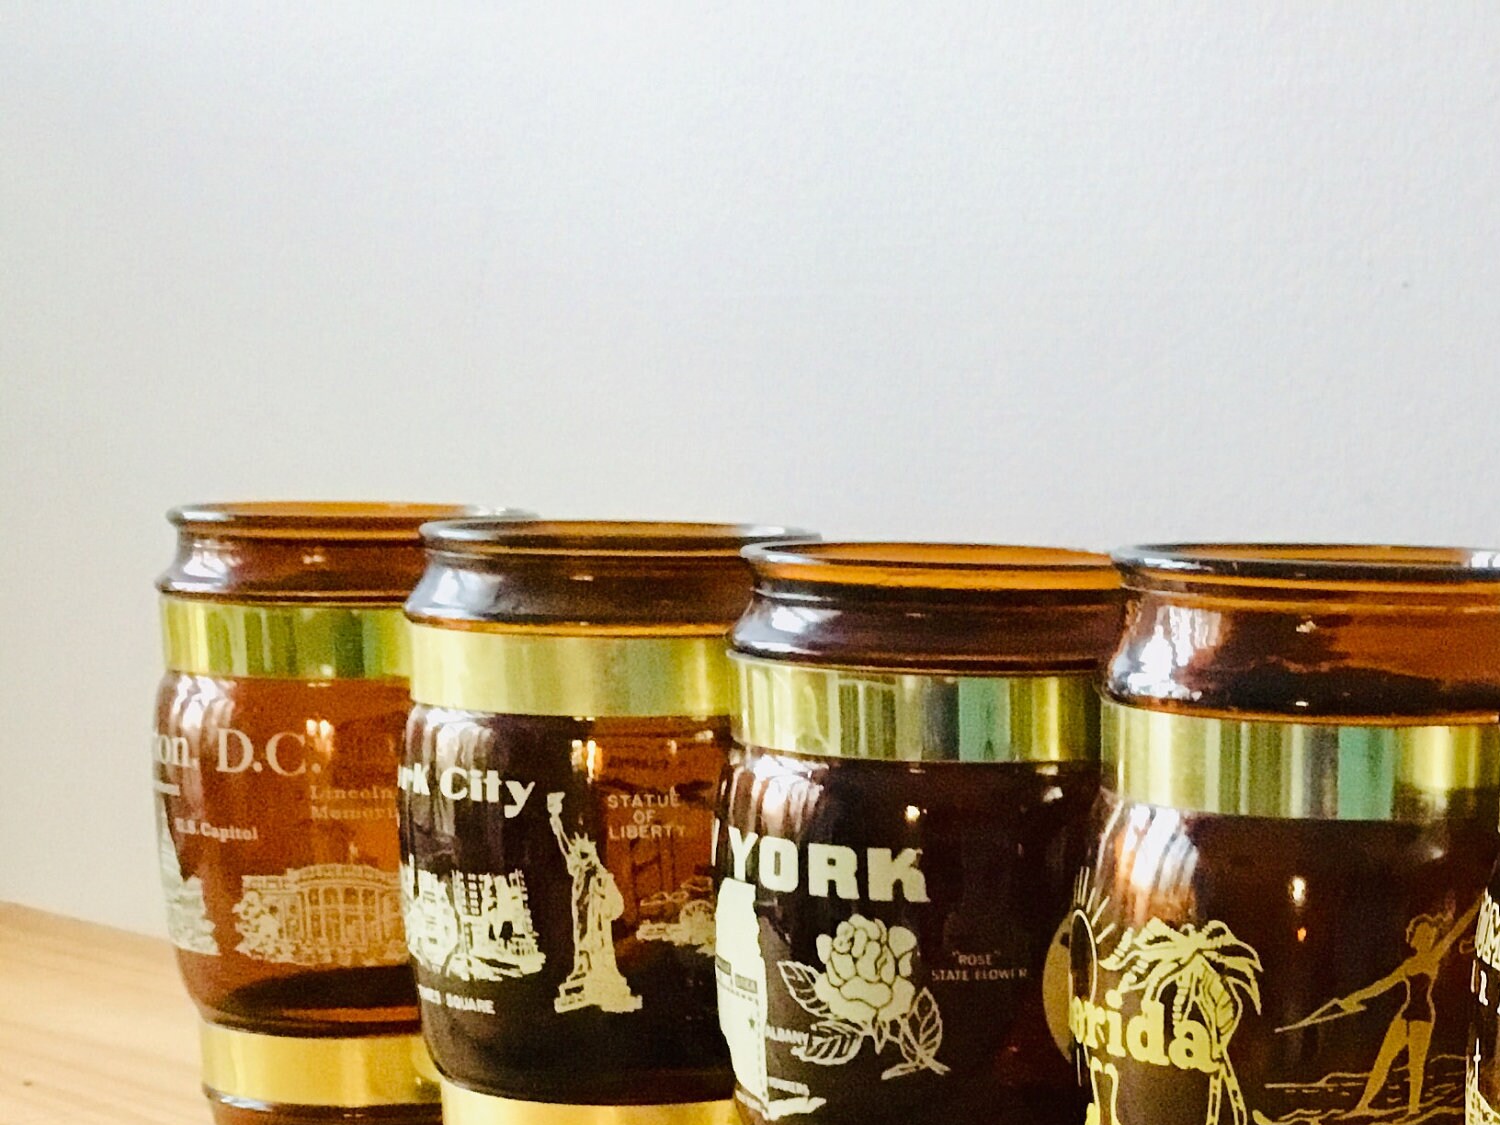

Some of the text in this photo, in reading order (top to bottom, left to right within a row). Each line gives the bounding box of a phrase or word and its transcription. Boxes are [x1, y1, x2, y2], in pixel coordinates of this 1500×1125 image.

[216, 728, 321, 776] D.C.
[440, 766, 536, 819] City
[607, 792, 681, 809] STATUE
[608, 824, 687, 840] LIBERTY
[633, 809, 656, 825] OF
[728, 826, 931, 903] YORK
[1069, 989, 1221, 1073] orida
